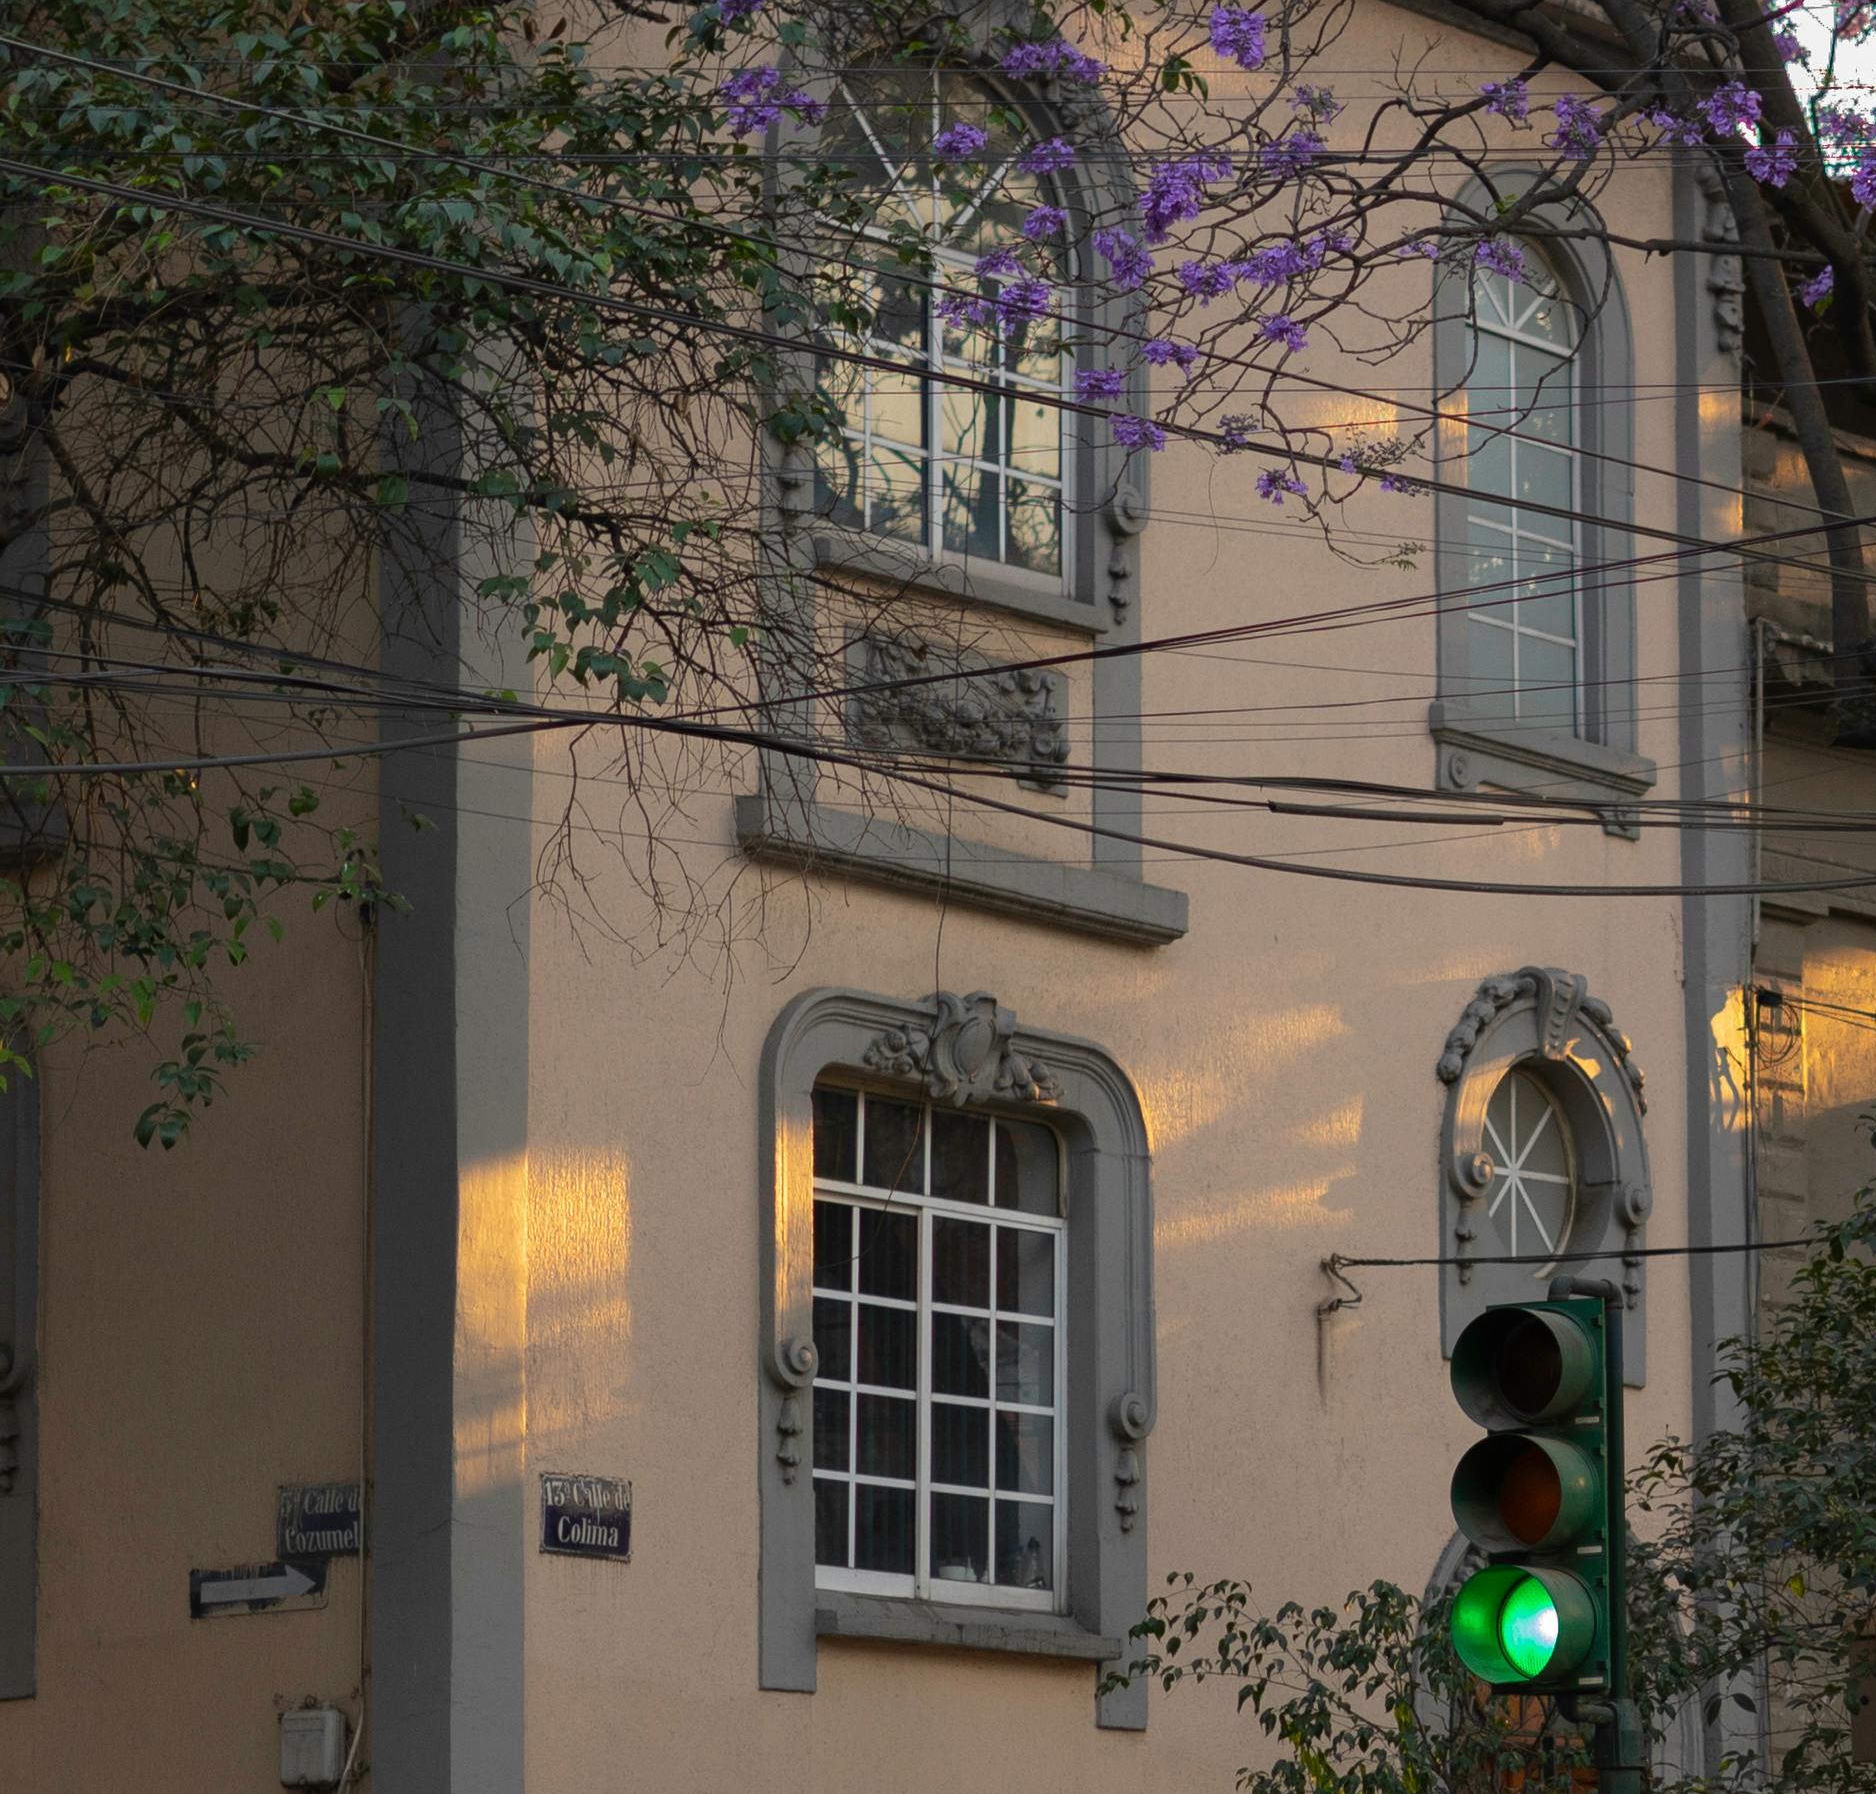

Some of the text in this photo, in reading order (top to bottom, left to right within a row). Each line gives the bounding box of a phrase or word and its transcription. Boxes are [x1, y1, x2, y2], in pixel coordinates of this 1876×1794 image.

[304, 1488, 344, 1515] Calle
[572, 1481, 611, 1510] Calle
[614, 1484, 631, 1512] de
[285, 1520, 360, 1554] Cozumel
[557, 1515, 619, 1547] Colima
